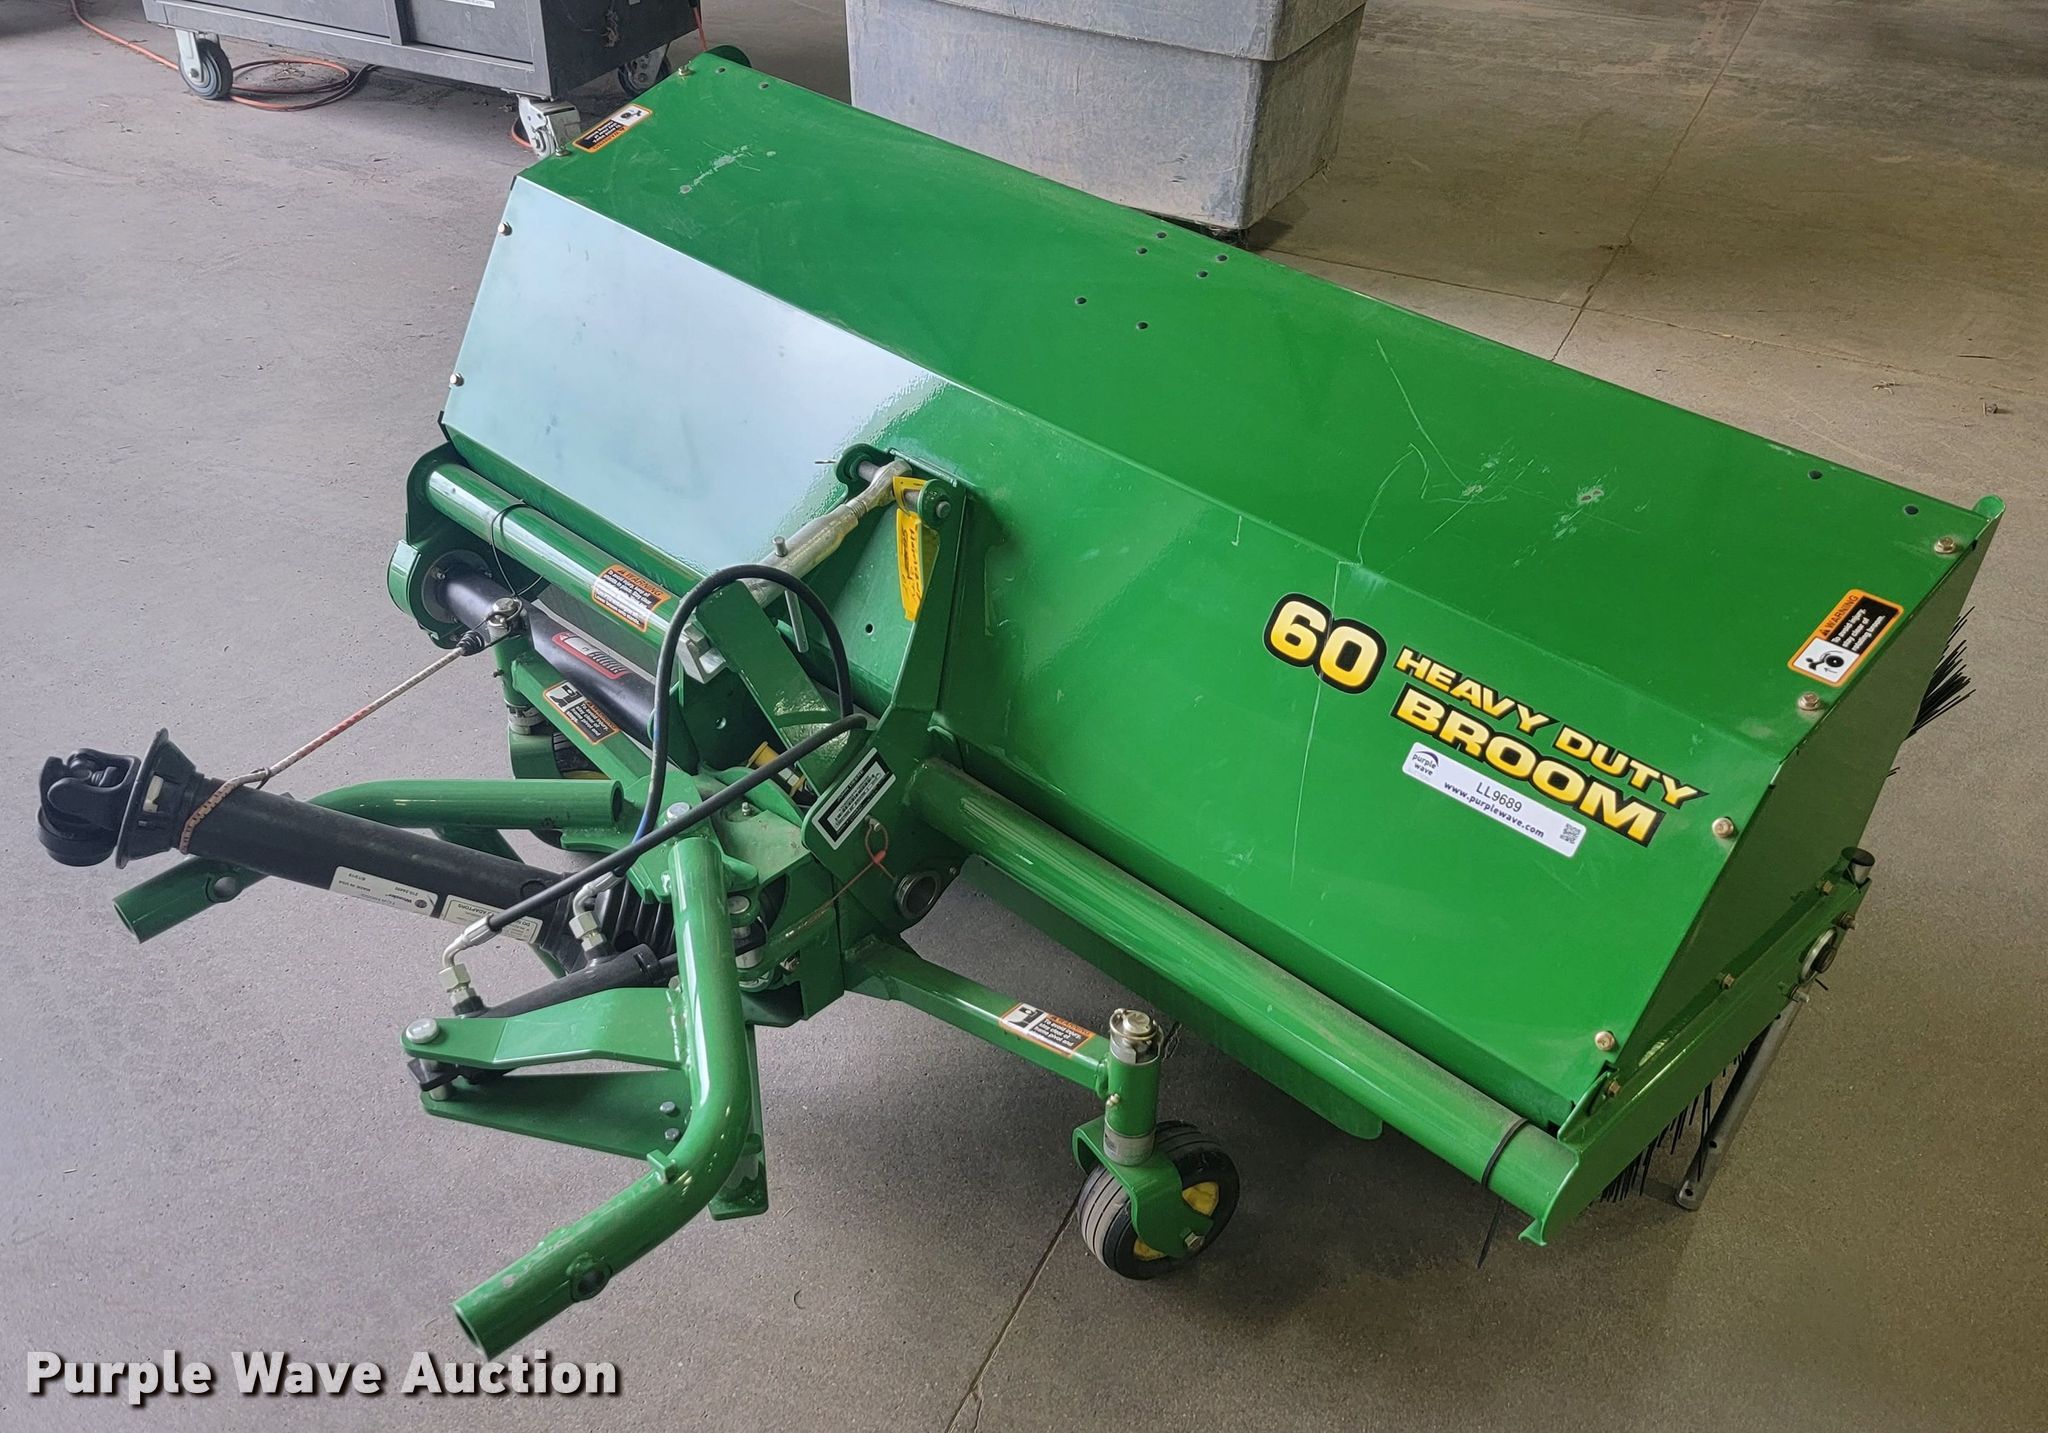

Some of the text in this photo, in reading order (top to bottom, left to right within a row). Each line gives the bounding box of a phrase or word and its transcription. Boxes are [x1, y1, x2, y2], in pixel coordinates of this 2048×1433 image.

[625, 571, 662, 596] WARNING
[1824, 595, 1859, 629] WARNING
[1266, 596, 1384, 691] 60
[1837, 622, 1853, 638] avoid
[1851, 623, 1865, 636] clear
[1394, 646, 1704, 807] HEAVY DUTY
[1393, 685, 1664, 844] BROOM
[1412, 753, 1437, 769] purple
[1414, 762, 1433, 776] wave
[1444, 781, 1544, 838] www.purplewave.com
[1476, 782, 1523, 813] LL9689
